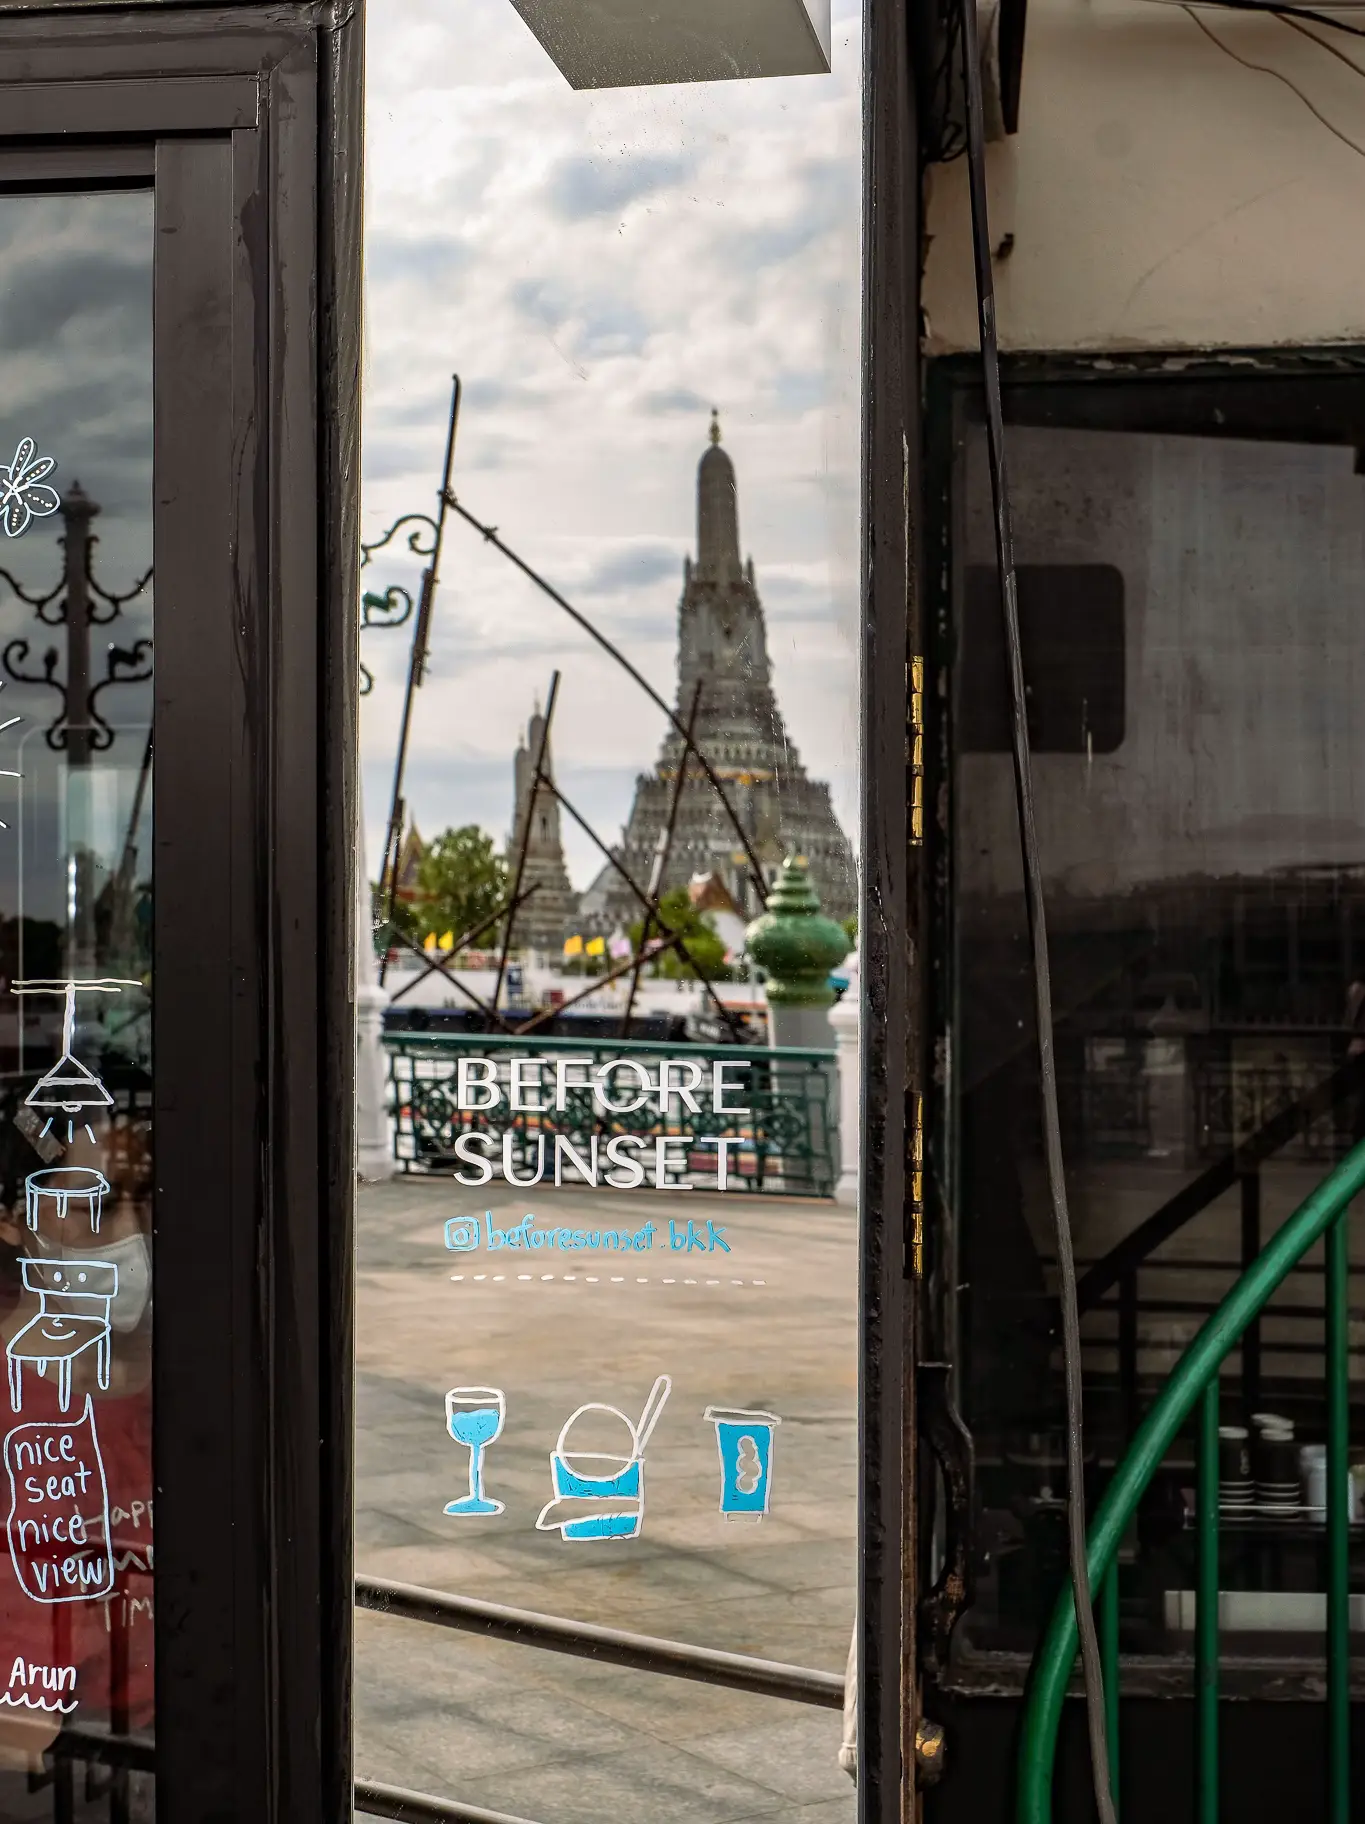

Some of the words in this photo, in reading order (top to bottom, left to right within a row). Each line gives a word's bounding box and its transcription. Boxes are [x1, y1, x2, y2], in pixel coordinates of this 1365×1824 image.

[455, 1057, 752, 1114] BEFORE
[453, 1132, 746, 1191] SUNSET
[485, 1211, 732, 1253] beforesunset.bkk
[14, 1433, 76, 1470] nice
[25, 1460, 92, 1503] seat
[16, 1514, 88, 1552] nice
[31, 1554, 103, 1593] view
[8, 1656, 77, 1692] Arun
